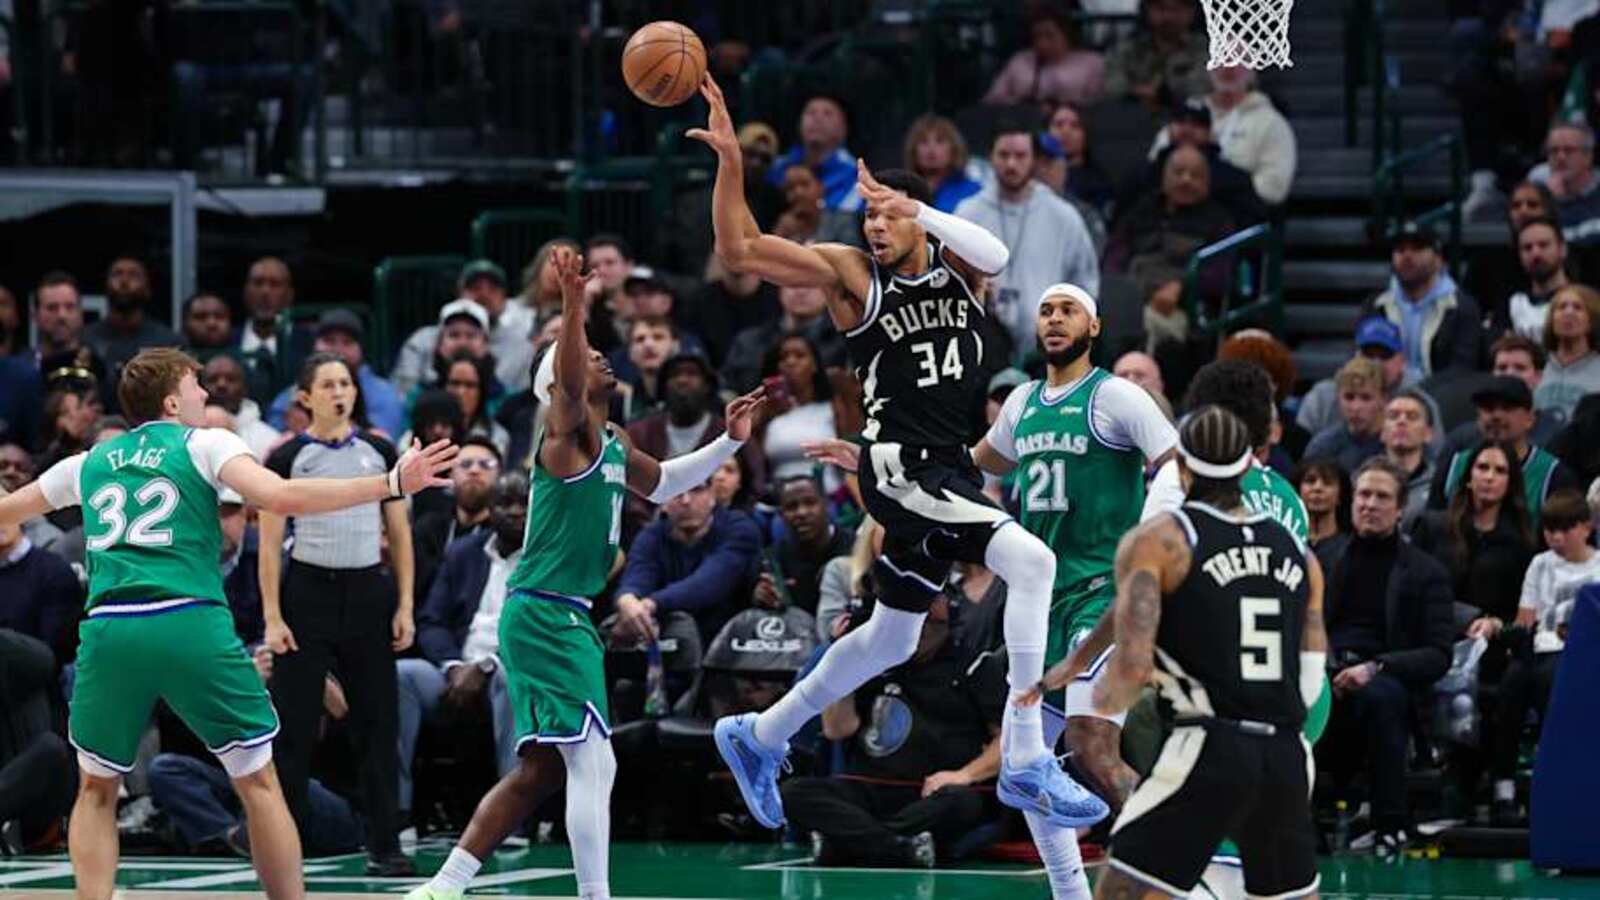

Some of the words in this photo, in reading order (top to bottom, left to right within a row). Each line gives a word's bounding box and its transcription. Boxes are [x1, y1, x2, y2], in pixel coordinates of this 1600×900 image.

[879, 298, 968, 343] BUCKS
[911, 336, 964, 388] 34
[107, 448, 166, 471] FLAGG
[1015, 432, 1088, 457] DALLAS
[1027, 459, 1069, 511] 21
[86, 476, 180, 551] 32
[1202, 547, 1272, 587] TRENT
[1274, 557, 1304, 592] JR
[731, 638, 802, 652] LEXUS
[1240, 597, 1282, 681] 5
